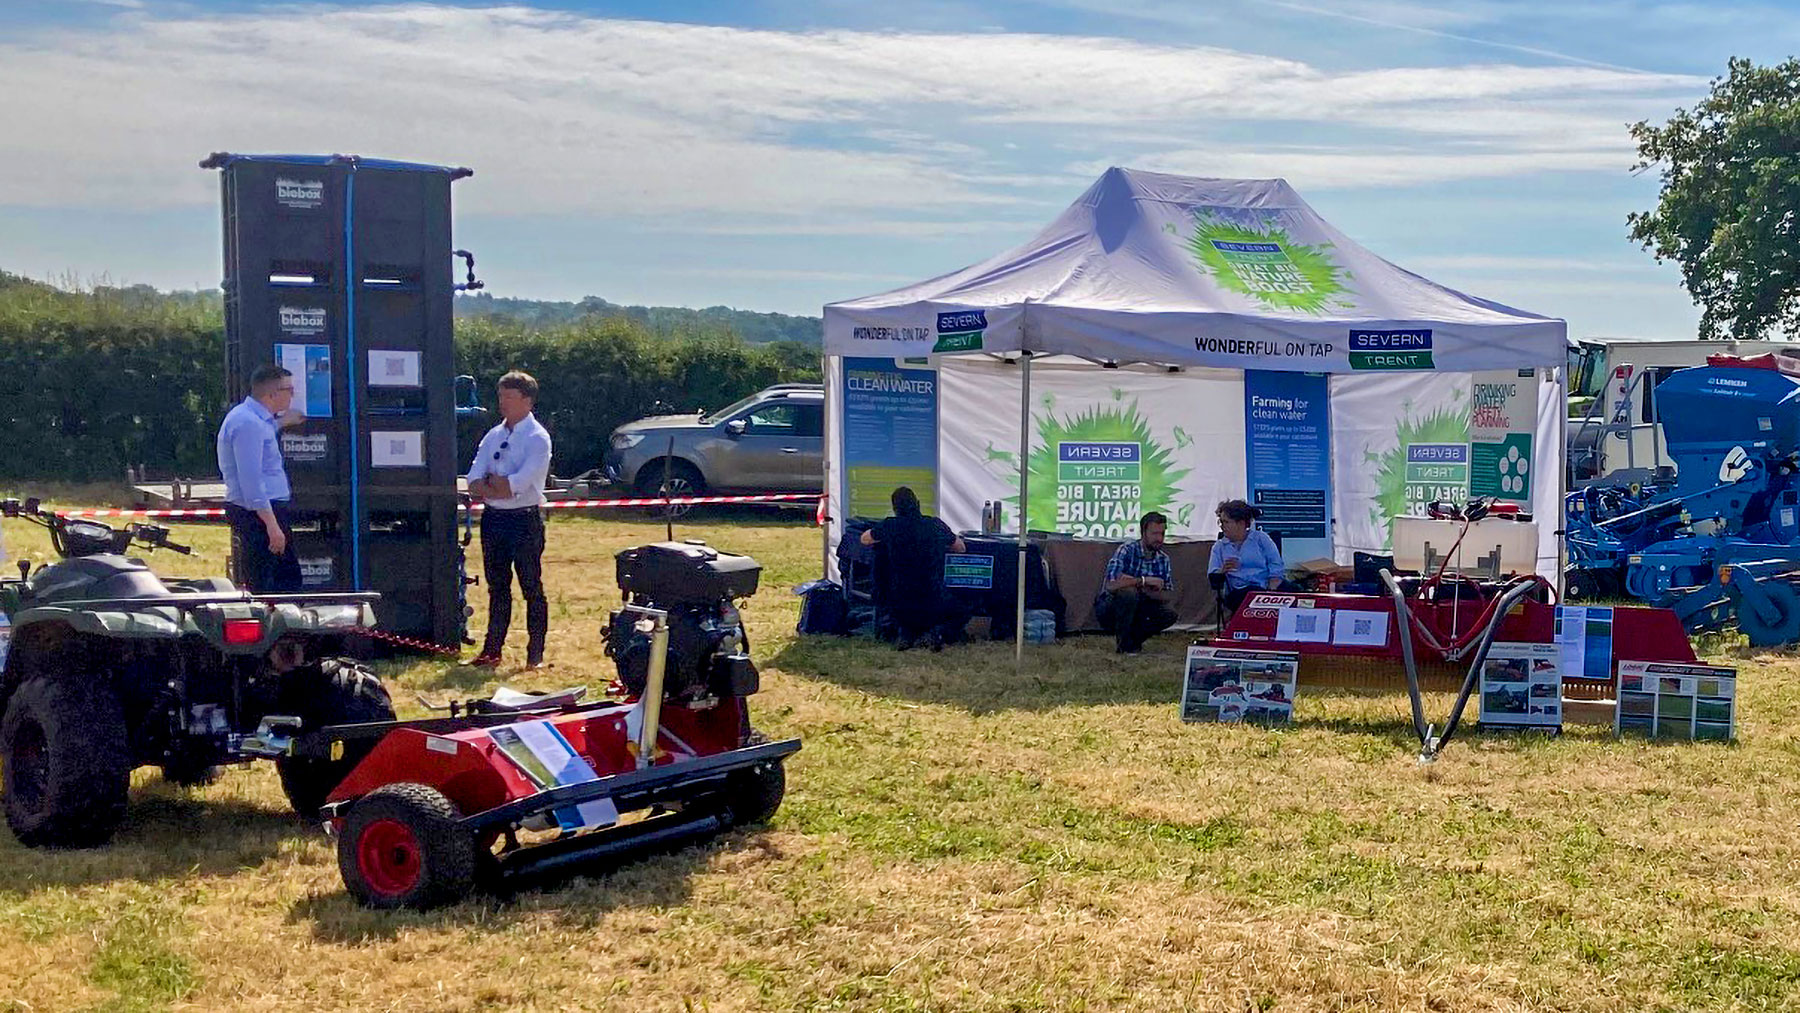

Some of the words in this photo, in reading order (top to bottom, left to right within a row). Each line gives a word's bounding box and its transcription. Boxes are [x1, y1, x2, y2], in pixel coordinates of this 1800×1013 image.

[1219, 243, 1274, 252] SEVERN
[1228, 262, 1269, 273] GREAT
[1275, 264, 1299, 272] BIG
[1233, 270, 1309, 283] NATURE
[1243, 282, 1316, 294] BOOST
[940, 314, 983, 329] SEVERN
[854, 327, 901, 341] WONDERFUL
[903, 328, 914, 341] ON
[915, 327, 930, 341] TAP
[1357, 334, 1424, 346] SEVERN
[1195, 337, 1281, 355] WONDERFUL
[1285, 342, 1305, 356] ON
[1309, 343, 1333, 357] TAP
[1364, 355, 1418, 366] TRENT
[848, 378, 888, 392] CLEAN
[888, 379, 933, 394] WATER
[1474, 384, 1516, 397] DRINKING
[1252, 396, 1292, 410] Farming
[1295, 398, 1309, 409] for
[1474, 396, 1506, 410] WATER
[1252, 409, 1278, 419] clean
[1279, 411, 1308, 421] water
[1473, 407, 1504, 418] SAFETY
[1472, 416, 1510, 428] PLANNING
[1255, 596, 1293, 605] LOGIC
